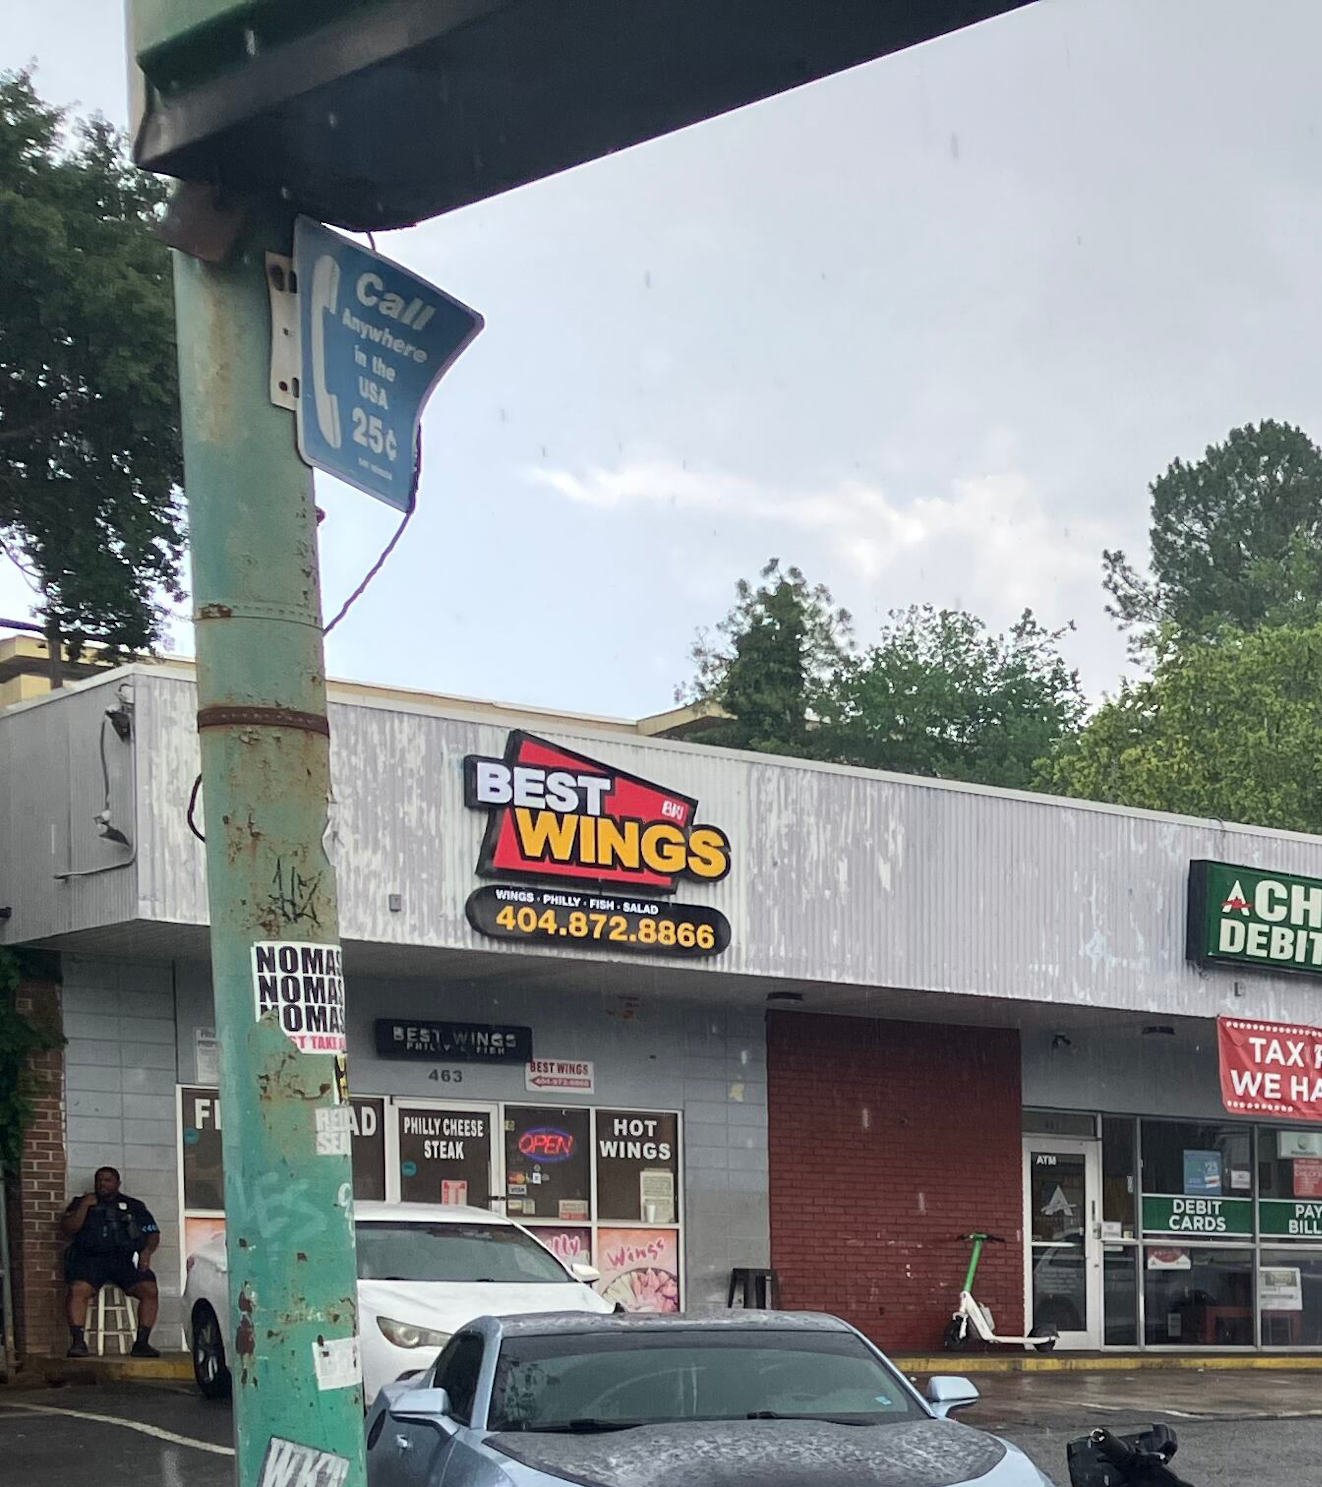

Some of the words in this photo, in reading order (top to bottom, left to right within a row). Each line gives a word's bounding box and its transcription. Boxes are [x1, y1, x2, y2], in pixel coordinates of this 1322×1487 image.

[356, 272, 436, 331] Call
[342, 307, 428, 363] Anywhere
[353, 344, 368, 368] in
[371, 353, 396, 382] the
[358, 376, 389, 410] USA
[352, 406, 398, 461] 25¢
[476, 761, 612, 816] BEST
[514, 807, 727, 878] WINGS
[496, 888, 535, 903] WINGS
[543, 894, 581, 908] PHILLY
[589, 898, 615, 911] FISH
[622, 901, 659, 915] SALAD
[495, 904, 716, 949] 404.872.8866
[392, 1025, 441, 1043] BEST
[452, 1031, 517, 1048] WINGS
[1249, 1037, 1305, 1068] TAX
[428, 1068, 464, 1084] 463
[529, 1060, 556, 1074] BEST
[556, 1061, 589, 1076] WINGS
[1230, 1069, 1282, 1099] WE
[403, 1116, 441, 1136] PHILLY
[442, 1119, 485, 1137] CHEESE
[613, 1118, 658, 1137] HOT
[423, 1140, 465, 1160] STEAK
[518, 1132, 574, 1156] OPEN
[600, 1140, 672, 1160] WINGS
[1036, 1154, 1058, 1166] ATM
[1172, 1198, 1223, 1215] DEBIT
[1168, 1214, 1227, 1232] CARDS
[607, 1239, 665, 1267] Wings
